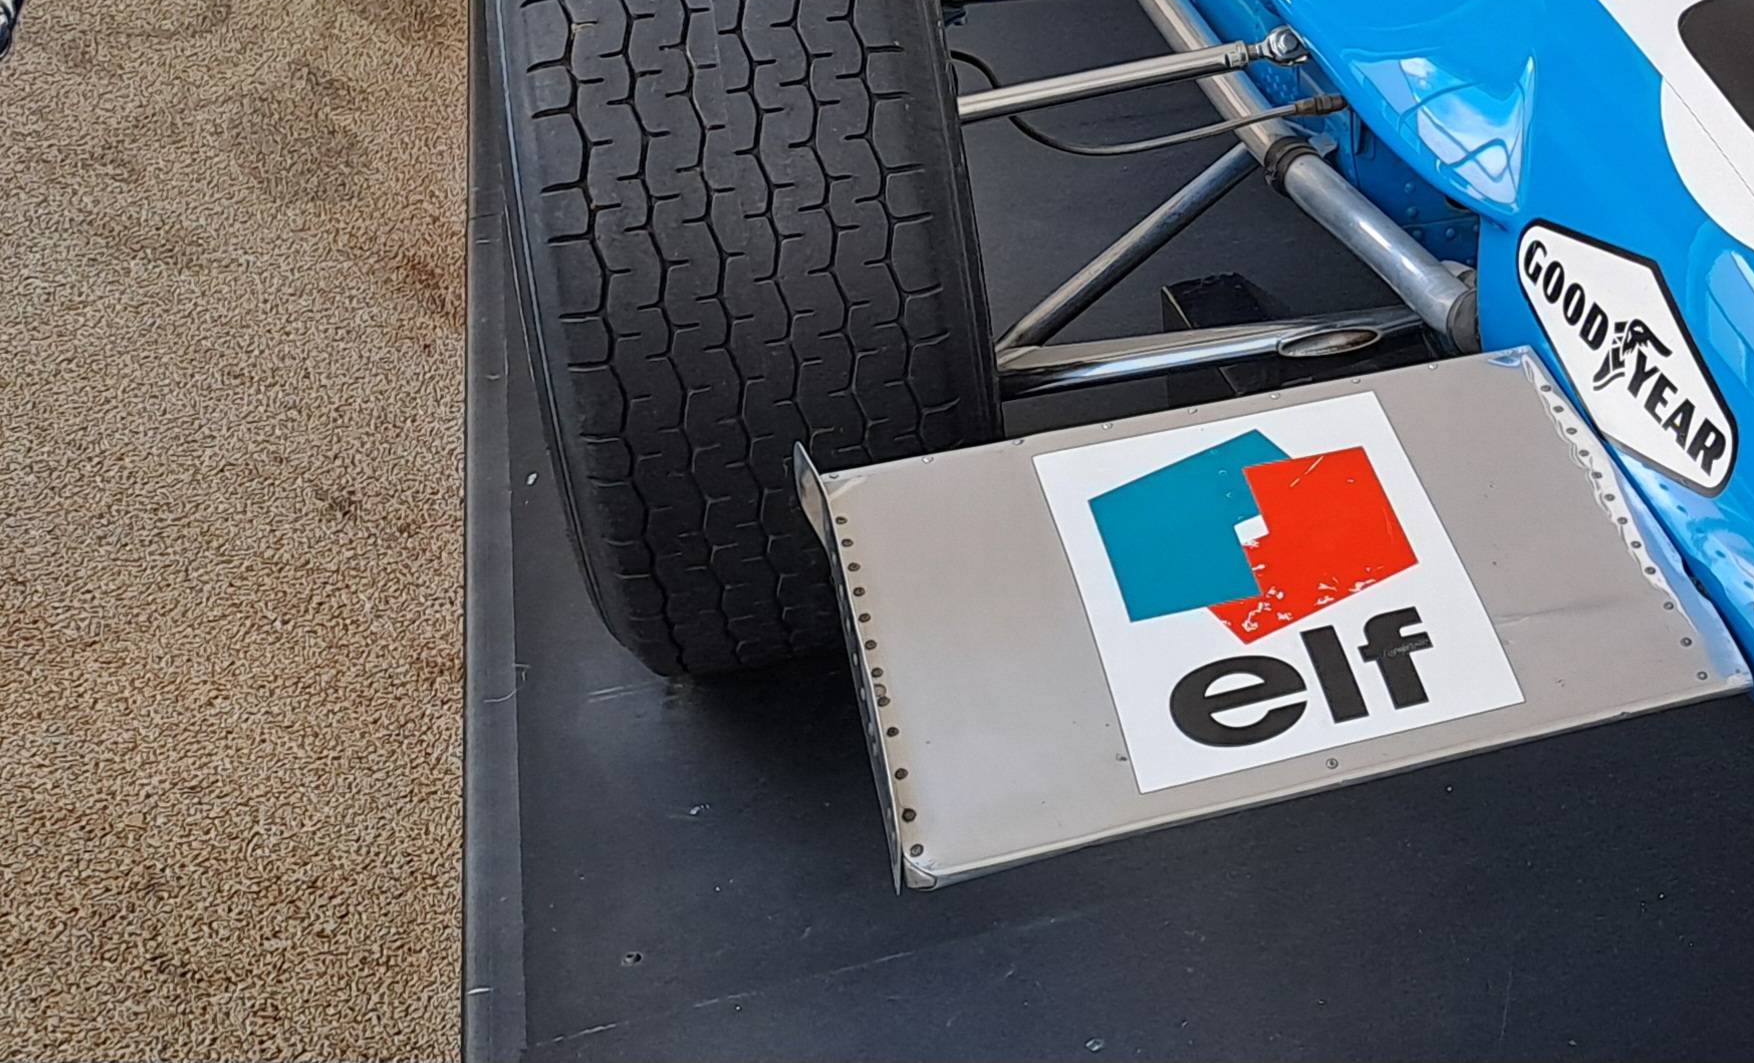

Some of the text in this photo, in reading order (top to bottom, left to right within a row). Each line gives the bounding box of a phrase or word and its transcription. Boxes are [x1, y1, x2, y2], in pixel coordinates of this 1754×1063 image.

[1524, 240, 1727, 477] GOOD YEAR
[1169, 606, 1432, 747] elf
